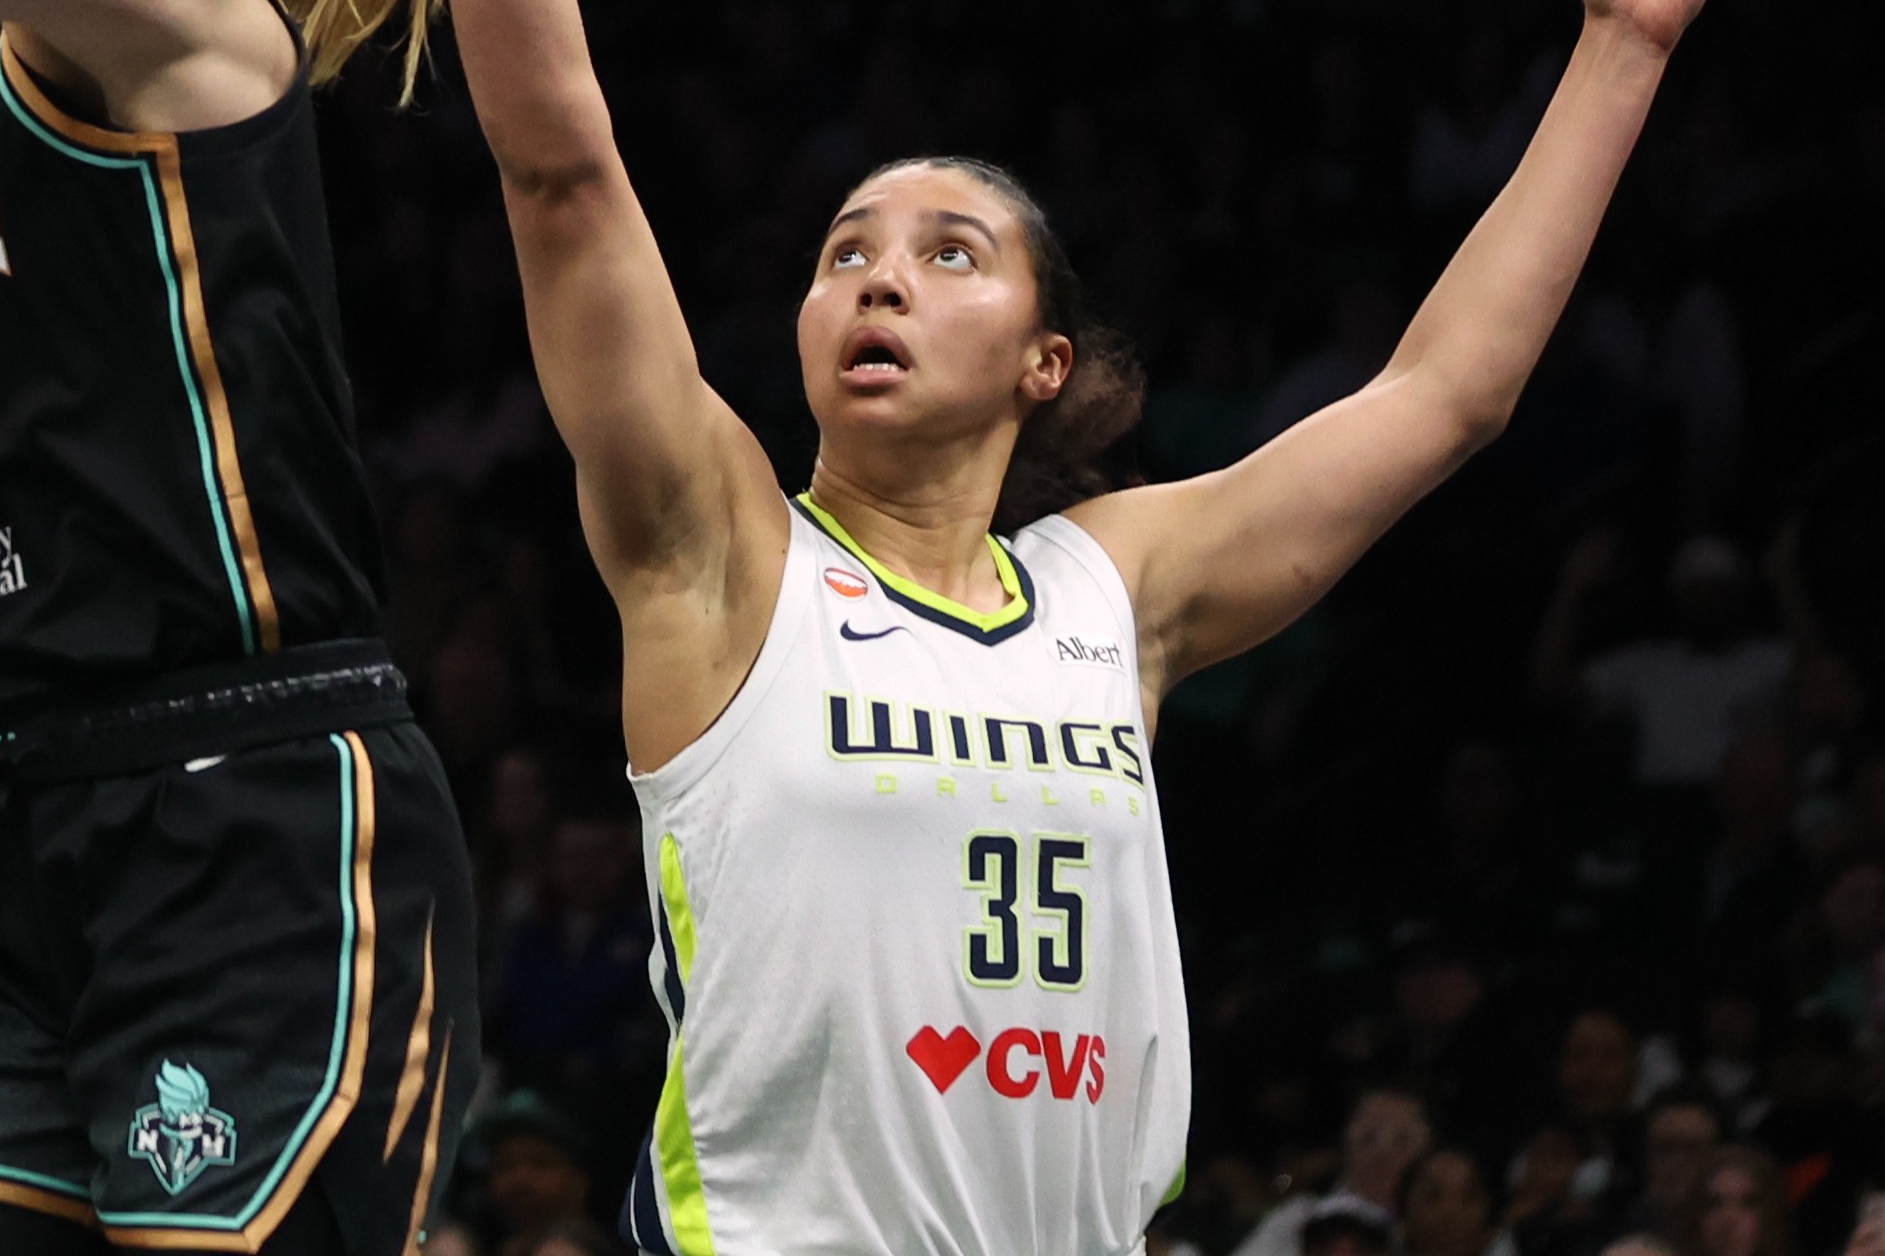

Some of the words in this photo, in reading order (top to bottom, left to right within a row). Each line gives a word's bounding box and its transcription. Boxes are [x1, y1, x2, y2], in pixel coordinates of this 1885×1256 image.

[825, 690, 1146, 792] WINGS
[875, 774, 1140, 816] DALLAS
[962, 828, 1091, 991] 35
[986, 1027, 1106, 1104] CVS
